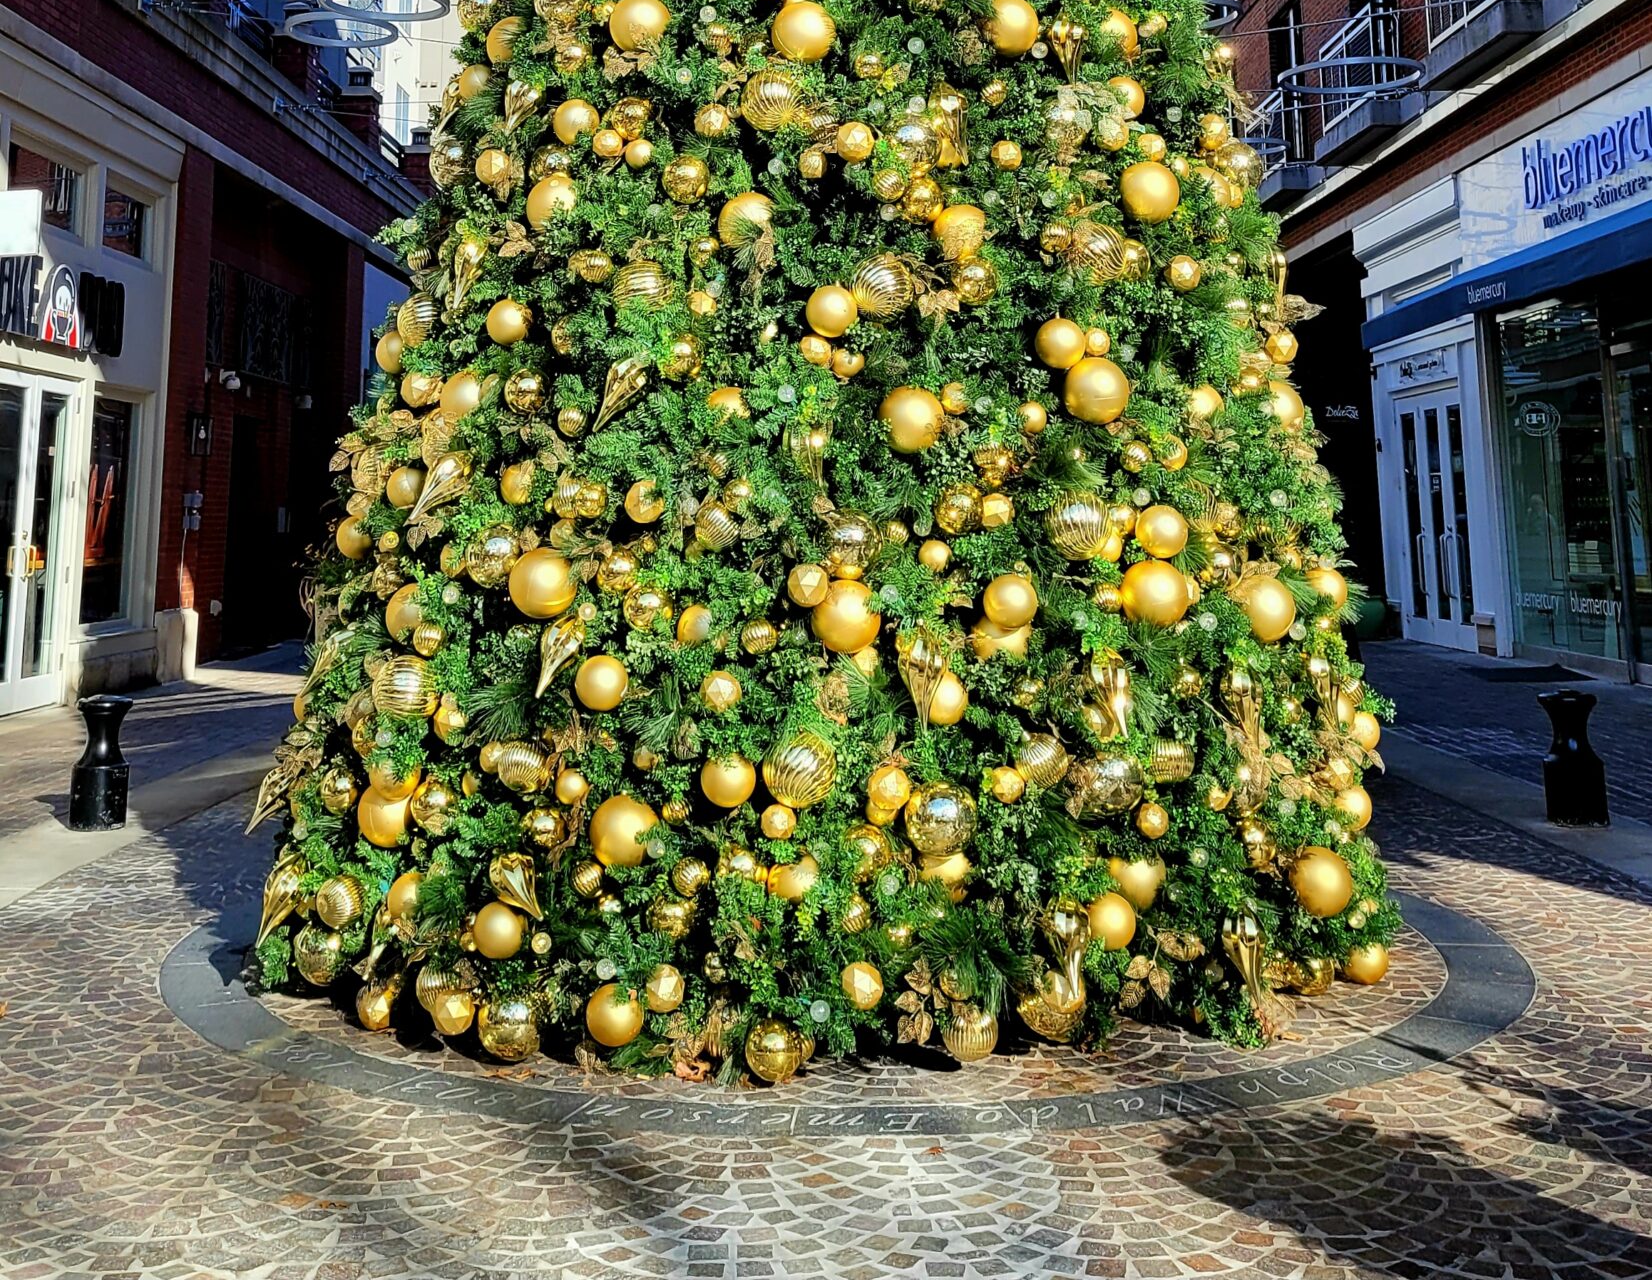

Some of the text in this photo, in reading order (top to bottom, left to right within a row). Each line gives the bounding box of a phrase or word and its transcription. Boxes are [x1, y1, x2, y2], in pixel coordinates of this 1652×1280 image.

[1543, 176, 1648, 229] makeup skincare
[1466, 281, 1506, 305] bluemercury
[1570, 589, 1622, 623] bluemercury
[1238, 1048, 1414, 1099] Ralph
[585, 1103, 930, 1133] Emerson
[975, 1090, 1217, 1128] Waldo
